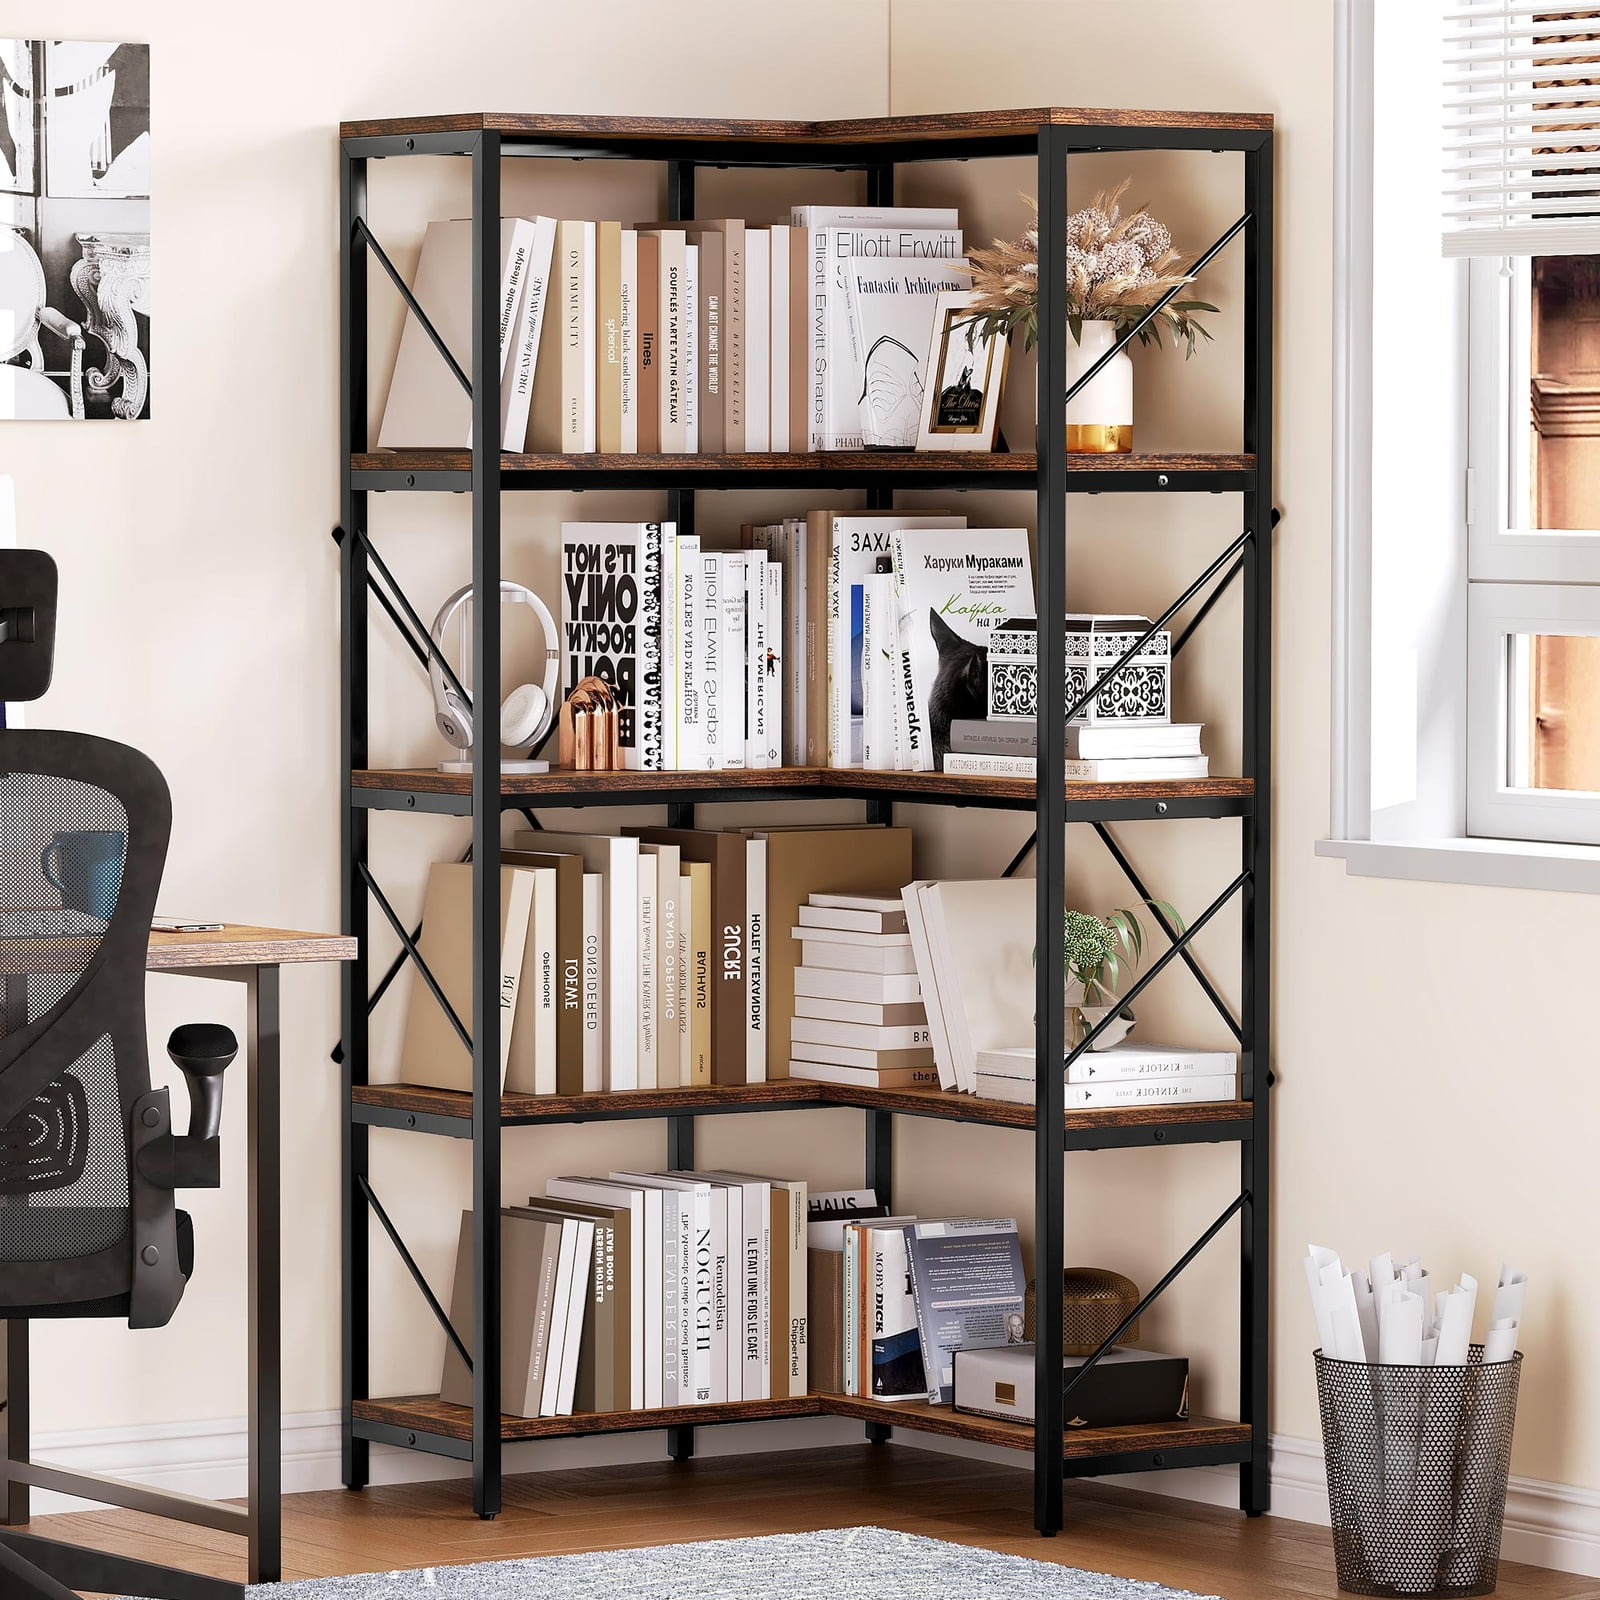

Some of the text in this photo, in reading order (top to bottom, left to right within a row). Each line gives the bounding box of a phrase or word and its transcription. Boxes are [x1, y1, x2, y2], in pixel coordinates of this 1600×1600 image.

[815, 232, 827, 287] Elliott
[836, 231, 958, 260] Elliott Erwitt
[500, 246, 526, 344] sustainable lifestyle
[569, 249, 579, 349] ON IMMUNITY
[856, 275, 962, 295] Fantastic Architecture
[517, 275, 544, 395] DREAM the world AWAKE
[605, 318, 620, 364] spherical
[621, 283, 632, 414] exploring black sand beaches
[643, 332, 654, 370] lines.
[669, 266, 680, 424] SOUFFLÉS TARTE TATIN GÂTEAUX
[708, 295, 719, 394] CAN ART CHANGE THE WORLD?
[732, 250, 740, 426] NATIONAL BESTSELLER
[815, 294, 827, 355] Erwitt
[834, 437, 865, 448] PHAID
[832, 544, 841, 620] ЗАХА ХАДИД
[923, 553, 1024, 572] Харуки Мураками
[977, 618, 991, 628] на
[900, 650, 920, 751] мураками
[696, 1228, 711, 1352] NOGUCHI
[715, 1254, 726, 1332] Remodelista
[747, 1237, 761, 1361] IL ÉTAIT UNE FOIS LE CAFÉ
[875, 1251, 885, 1292] MOBY
[798, 1317, 807, 1345] David
[875, 1292, 885, 1334] DICK
[790, 1318, 799, 1377] Chipperfield
